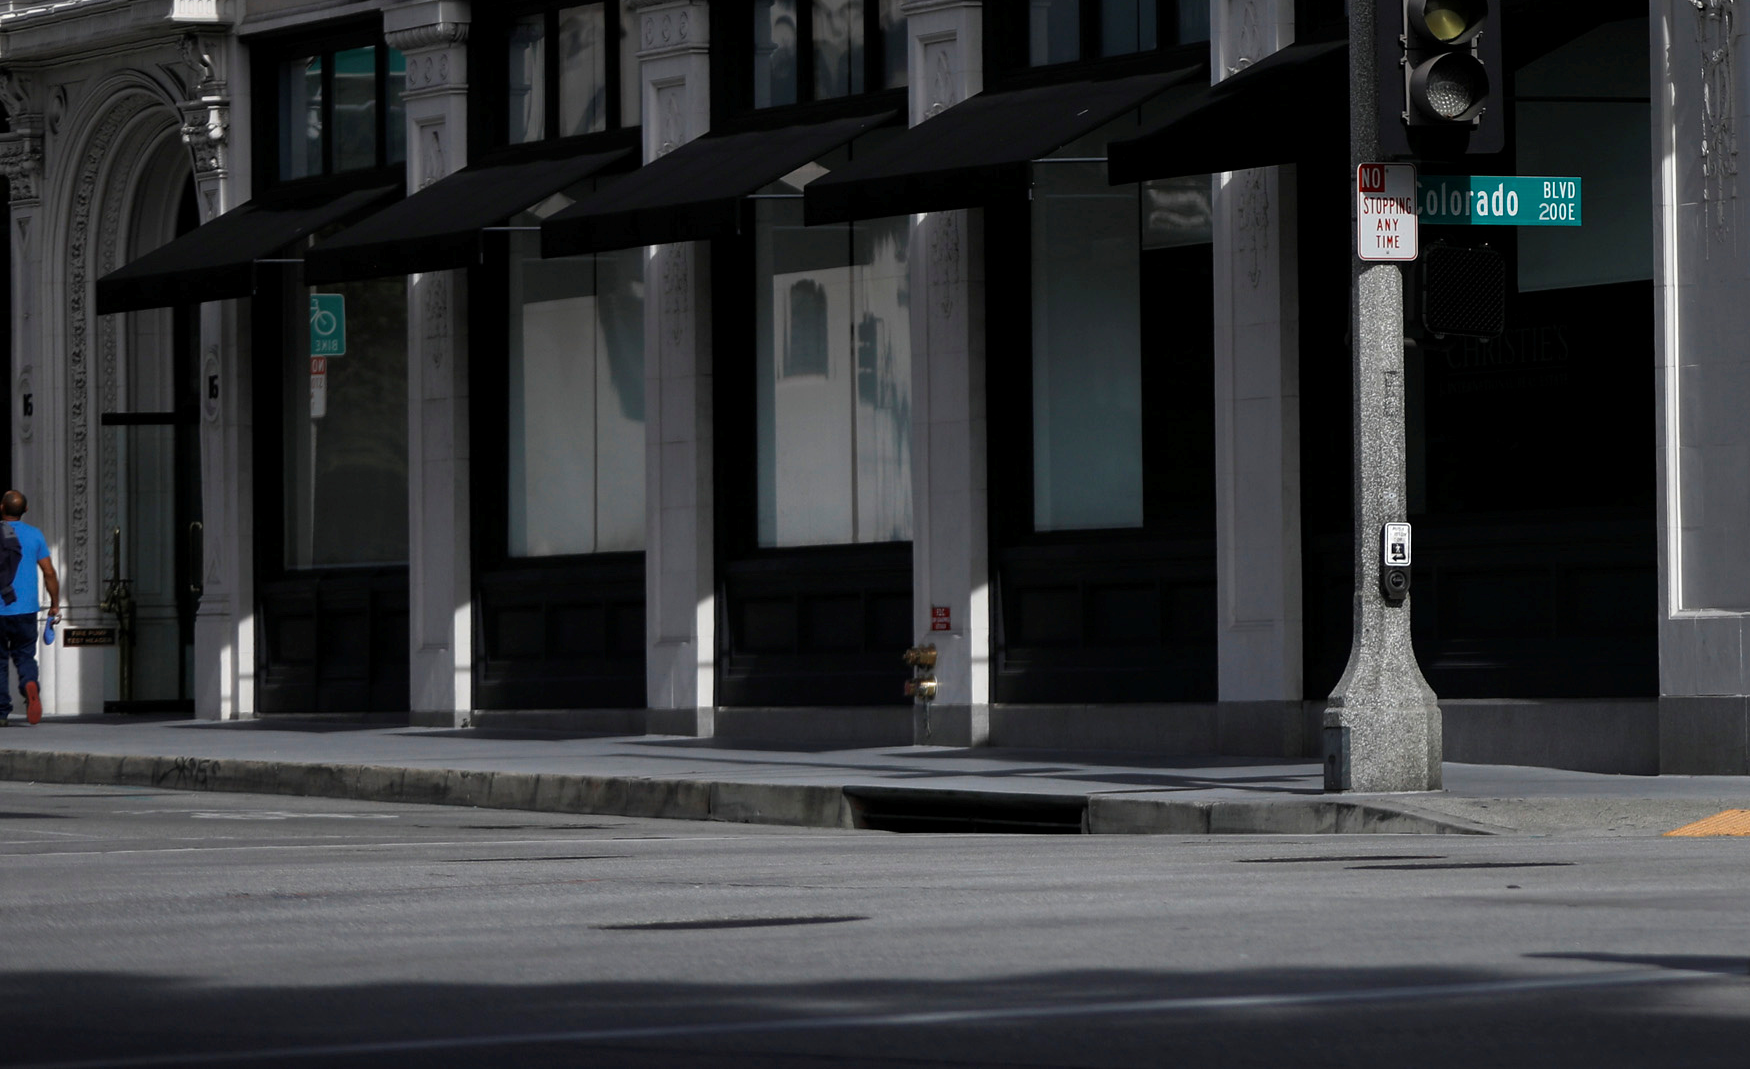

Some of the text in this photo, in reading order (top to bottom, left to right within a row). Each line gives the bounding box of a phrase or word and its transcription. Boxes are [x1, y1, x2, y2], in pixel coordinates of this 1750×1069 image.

[1361, 167, 1381, 189] NO
[1543, 181, 1576, 199] BLVD
[1363, 196, 1412, 215] STOPPING
[1538, 203, 1576, 221] 200E
[1376, 218, 1399, 232] ANY
[1376, 235, 1400, 249] TIME
